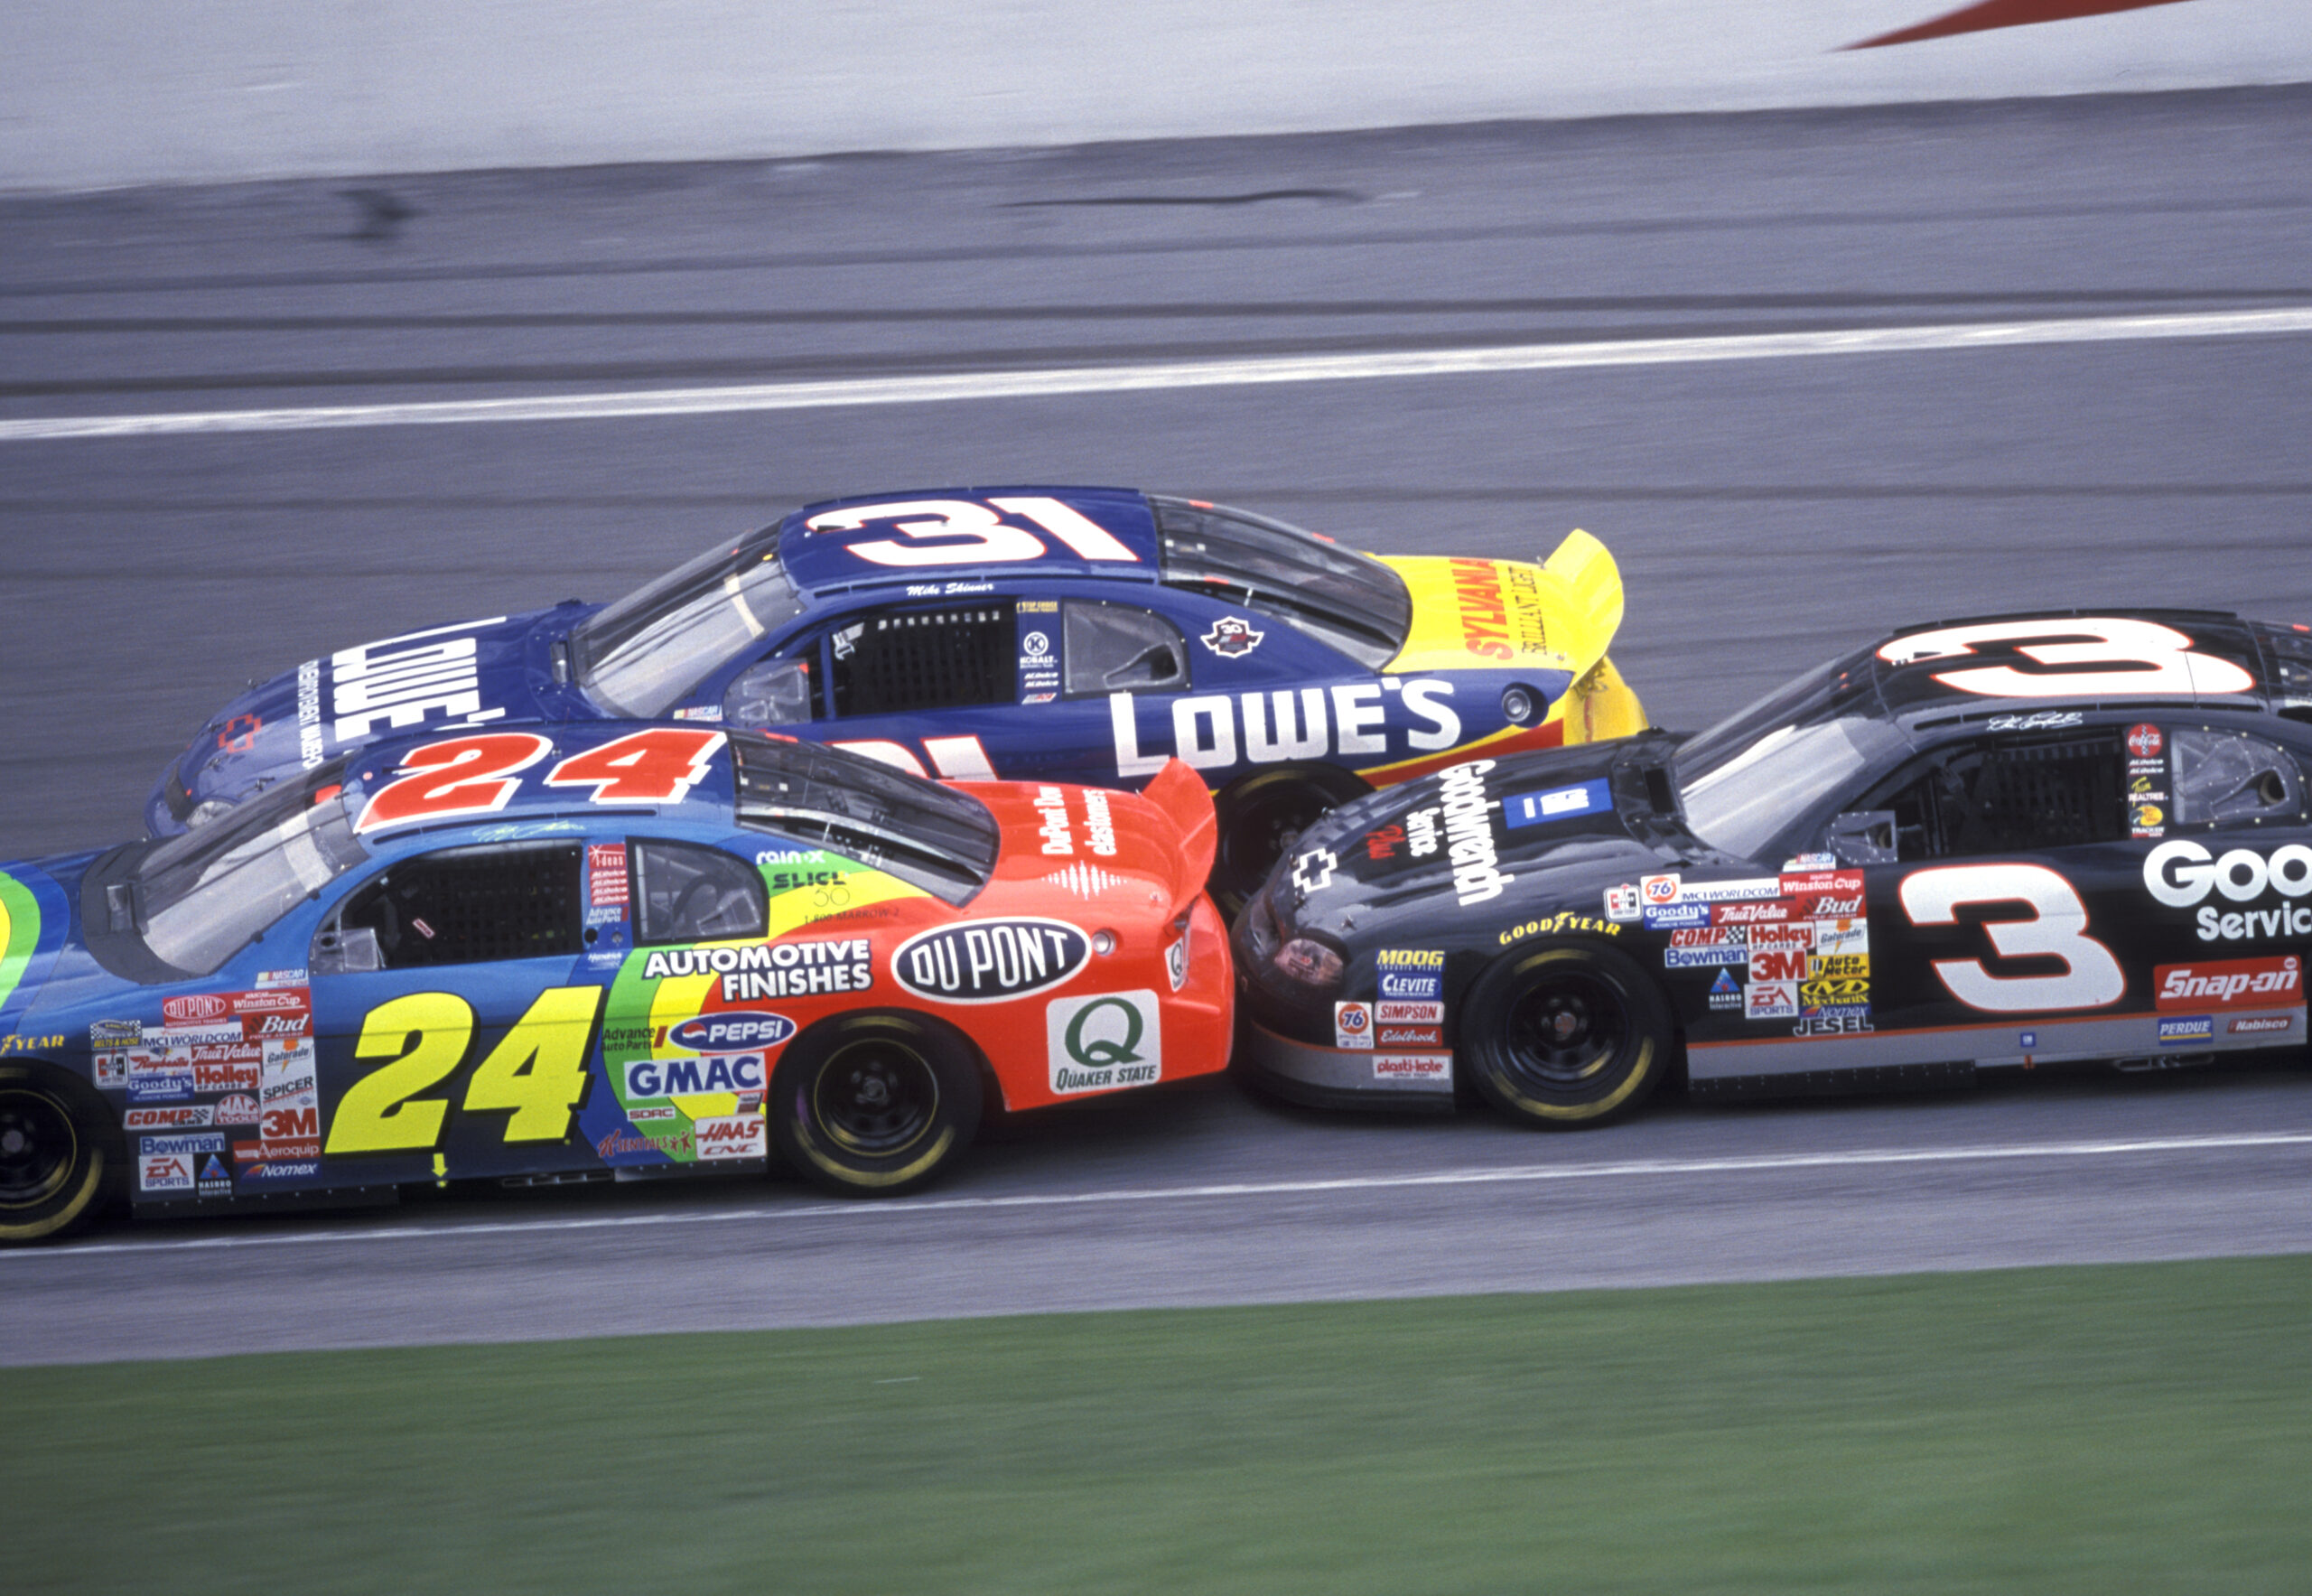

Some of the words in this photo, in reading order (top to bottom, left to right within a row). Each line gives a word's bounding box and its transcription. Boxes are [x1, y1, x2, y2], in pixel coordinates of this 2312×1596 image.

[806, 497, 1142, 566] 31
[906, 584, 940, 596] Mike
[945, 583, 994, 594] Skinner
[1875, 617, 2256, 697] 3
[1109, 677, 1461, 777] LOWE'S
[352, 728, 728, 834] 24
[1083, 789, 1118, 855] elastomers
[1406, 807, 1443, 858] Service
[1439, 760, 1515, 906] Goodwrench
[1651, 882, 1672, 896] 76
[1709, 887, 1779, 900] WORLDCOM
[1783, 880, 1833, 892] Winston
[1834, 877, 1861, 891] Cup
[1645, 903, 1710, 919] Goody's
[1719, 906, 1748, 923] True
[1743, 902, 1788, 920] Value
[1813, 895, 1863, 915] Bud
[1671, 928, 1728, 947] COMP
[1750, 924, 1813, 947] Holley
[1820, 929, 1862, 944] Gatorade
[1898, 862, 2128, 1013] 3
[644, 939, 870, 978] AUTOMOTIVE
[1376, 949, 1444, 966] MOOG
[1666, 948, 1747, 966] Bowman
[1751, 951, 1806, 981] 3M
[1826, 956, 1860, 966] Auto
[1823, 966, 1868, 977] Meter
[723, 964, 872, 1001] FINISHES
[1382, 974, 1437, 993] CLEVITE
[2159, 970, 2298, 1001] Snap-on
[233, 997, 277, 1009] Winston
[277, 995, 301, 1007] Cup
[1709, 994, 1741, 1003] HASBRO
[1751, 985, 1793, 1006] EA
[1380, 1004, 1438, 1020] SIMPSON
[1750, 1004, 1794, 1016] SPORTS
[1817, 1005, 1868, 1018] Nomex
[259, 1013, 311, 1034] Bud
[1343, 1012, 1364, 1027] 76
[1793, 1016, 1874, 1037] JESEL
[2159, 1020, 2212, 1035] PERDUE
[2234, 1018, 2289, 1031] Nabisco
[171, 1031, 242, 1046] WORLDCOM
[602, 1027, 656, 1041] Advance
[708, 1020, 783, 1043] PEPSI
[1065, 996, 1145, 1067] Q
[1380, 1029, 1438, 1043] Edelbrock
[192, 1046, 222, 1061] True
[216, 1043, 261, 1060] Value
[627, 1039, 653, 1050] Parts
[267, 1048, 310, 1063] Gatorade
[195, 1066, 258, 1088] Holley
[324, 985, 602, 1154] 24
[629, 1055, 762, 1097] GMAC
[1056, 1068, 1113, 1091] QUAKER
[1117, 1065, 1157, 1082] STATE
[128, 1077, 192, 1091] Goody's
[263, 1076, 313, 1100] SPICER
[218, 1095, 260, 1114] MAC
[127, 1109, 192, 1125] COMP
[217, 1114, 261, 1124] TOOLS
[262, 1107, 318, 1137] 3M
[695, 1120, 765, 1143] HAAS
[141, 1138, 225, 1153] Bowman
[258, 1142, 319, 1159] Aeroquip
[704, 1143, 758, 1155] CNC
[145, 1157, 188, 1178] EA
[261, 1163, 318, 1178] Nomex
[145, 1177, 190, 1188] SPORTS
[199, 1180, 232, 1189] HASBRO
